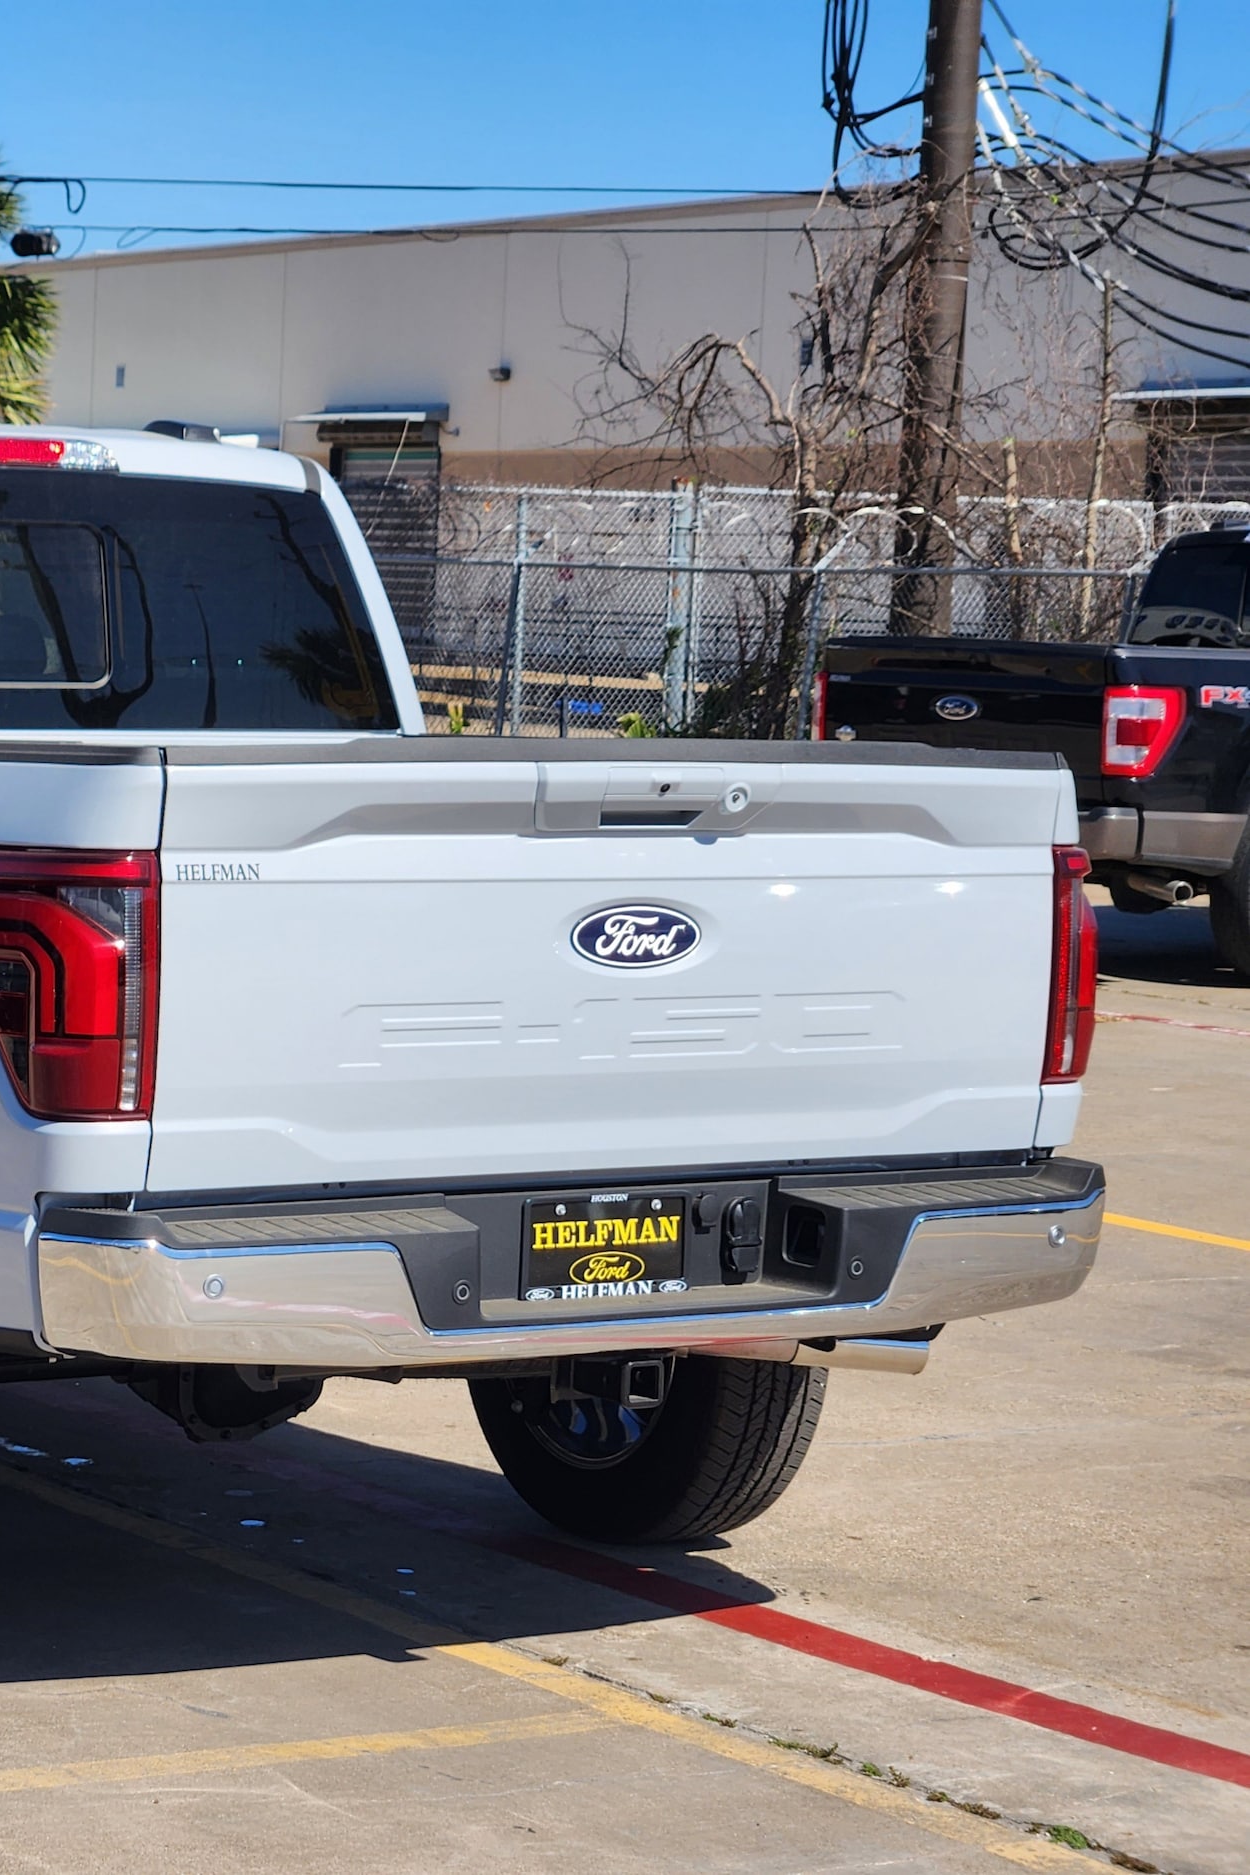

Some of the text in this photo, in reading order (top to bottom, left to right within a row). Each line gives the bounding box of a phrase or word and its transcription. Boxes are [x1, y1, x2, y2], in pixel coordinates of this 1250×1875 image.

[175, 863, 261, 881] HELFMAN
[595, 914, 687, 956] Ford
[590, 1193, 629, 1203] HOUSTON
[532, 1215, 681, 1249] HELFMAN
[583, 1255, 631, 1282] Ford
[561, 1279, 654, 1300] HELFMAN
